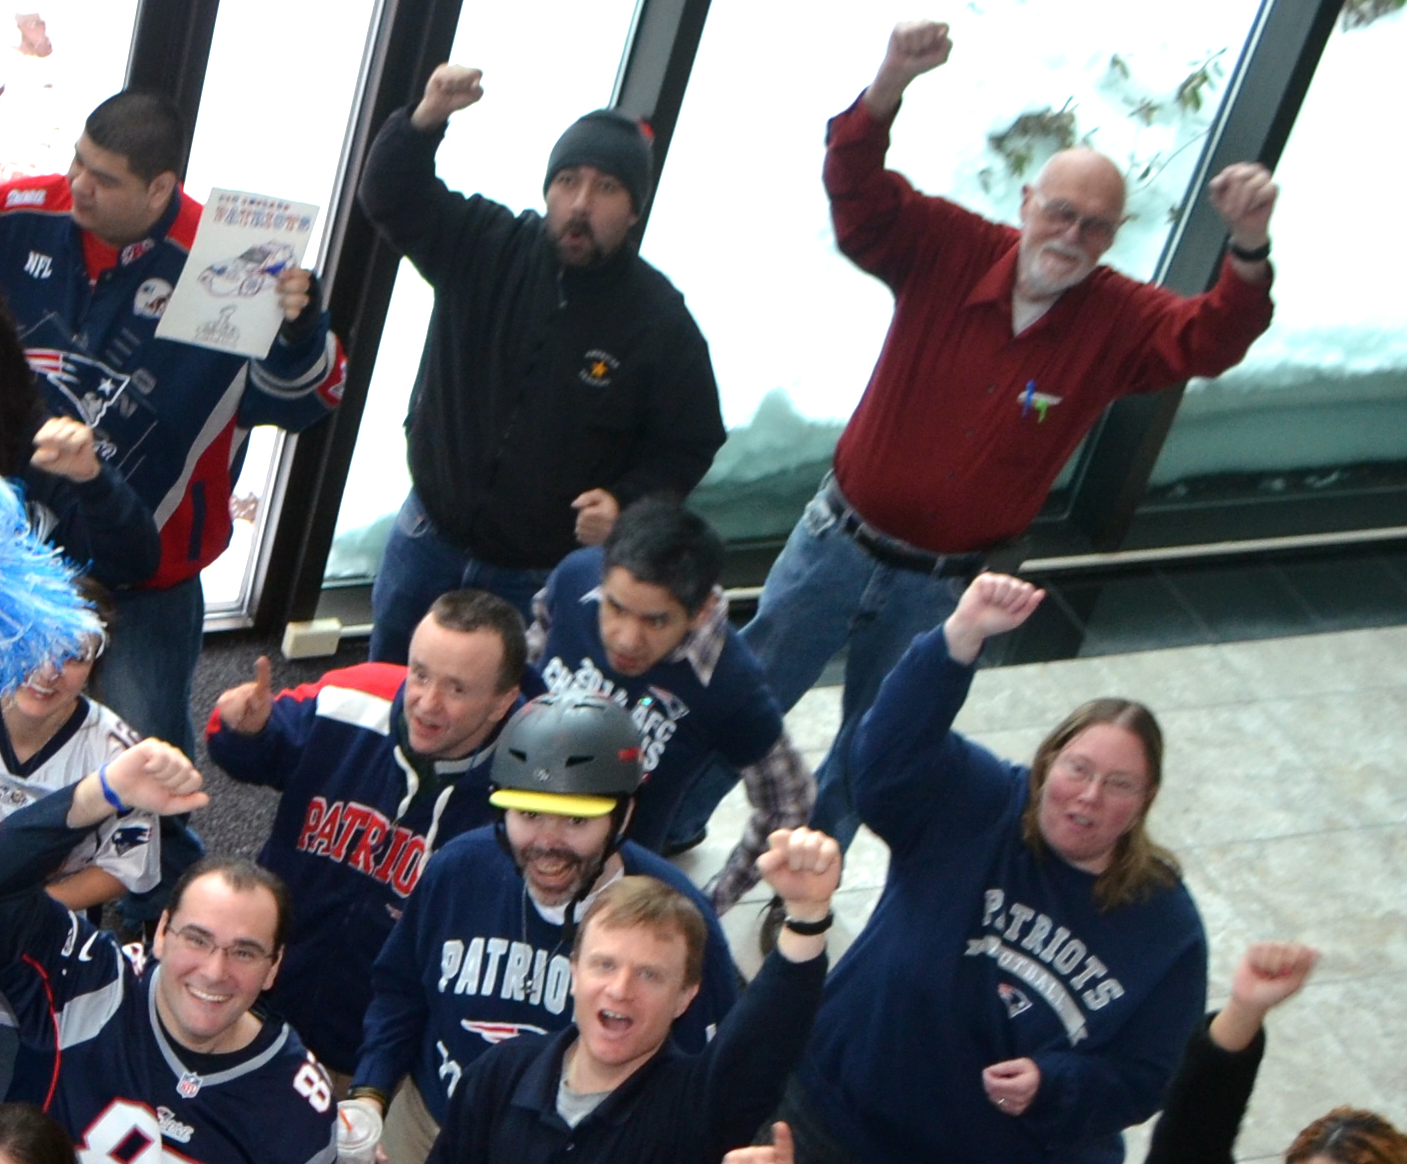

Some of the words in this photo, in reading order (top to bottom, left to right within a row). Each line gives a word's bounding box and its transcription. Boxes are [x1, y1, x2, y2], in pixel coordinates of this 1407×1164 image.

[23, 249, 54, 280] NFL
[297, 796, 426, 898] PATRIO
[438, 936, 572, 1016] PATRIO
